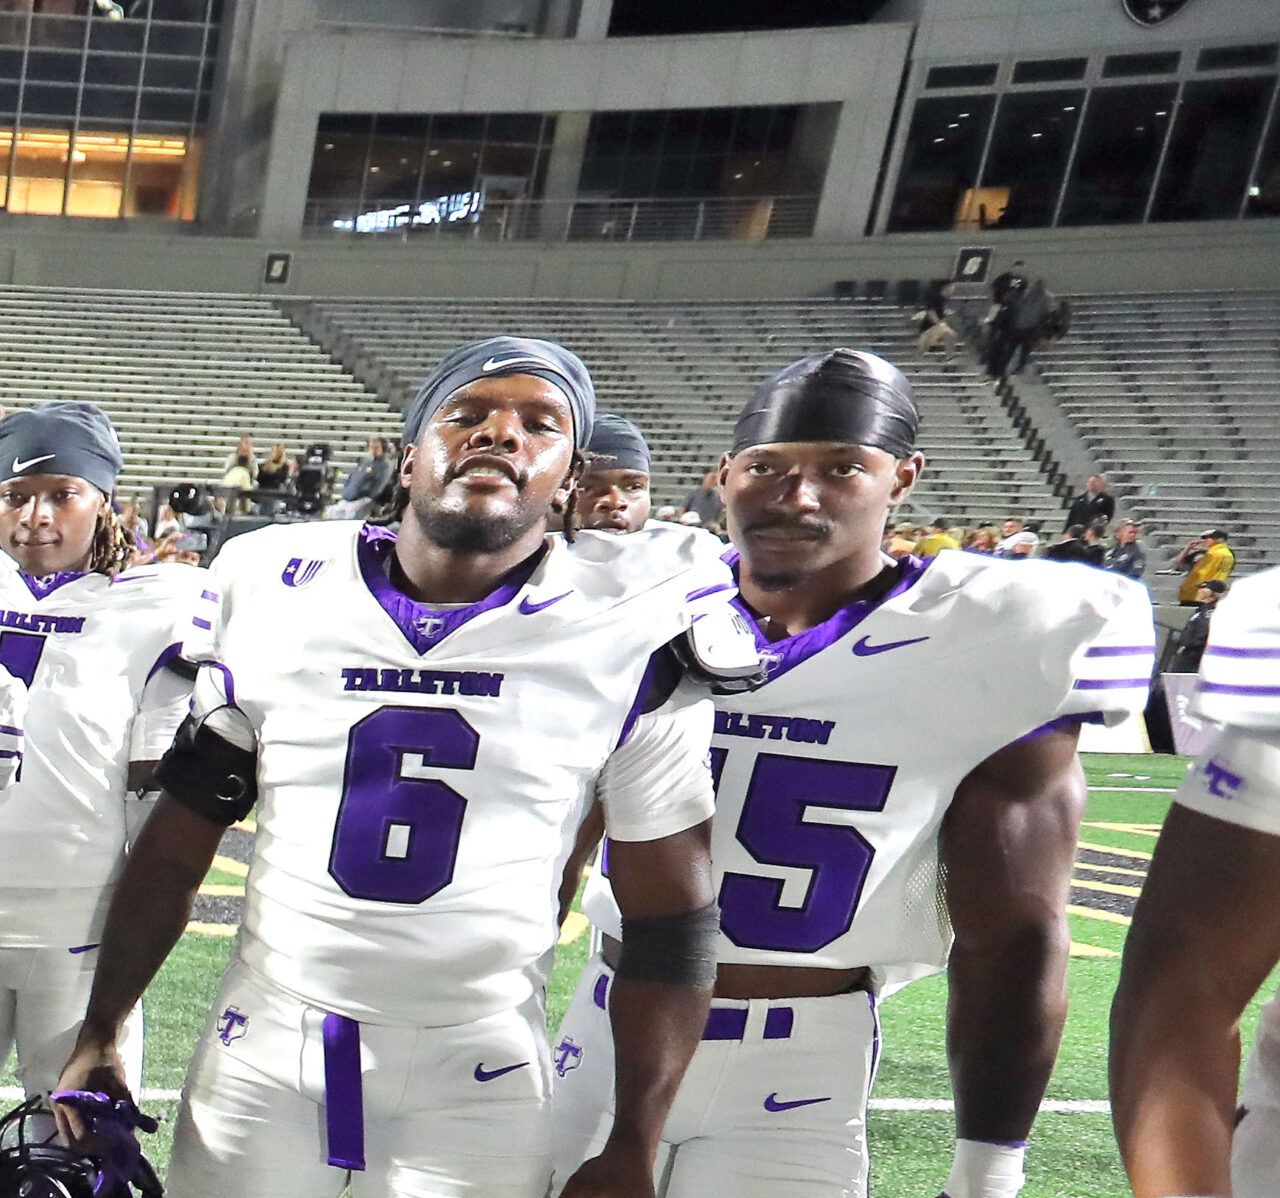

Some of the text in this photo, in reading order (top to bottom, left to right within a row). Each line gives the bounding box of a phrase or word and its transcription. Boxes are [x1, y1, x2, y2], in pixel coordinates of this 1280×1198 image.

[342, 667, 505, 698] TARLETON
[713, 710, 836, 745] RLETON
[328, 704, 481, 905] 6
